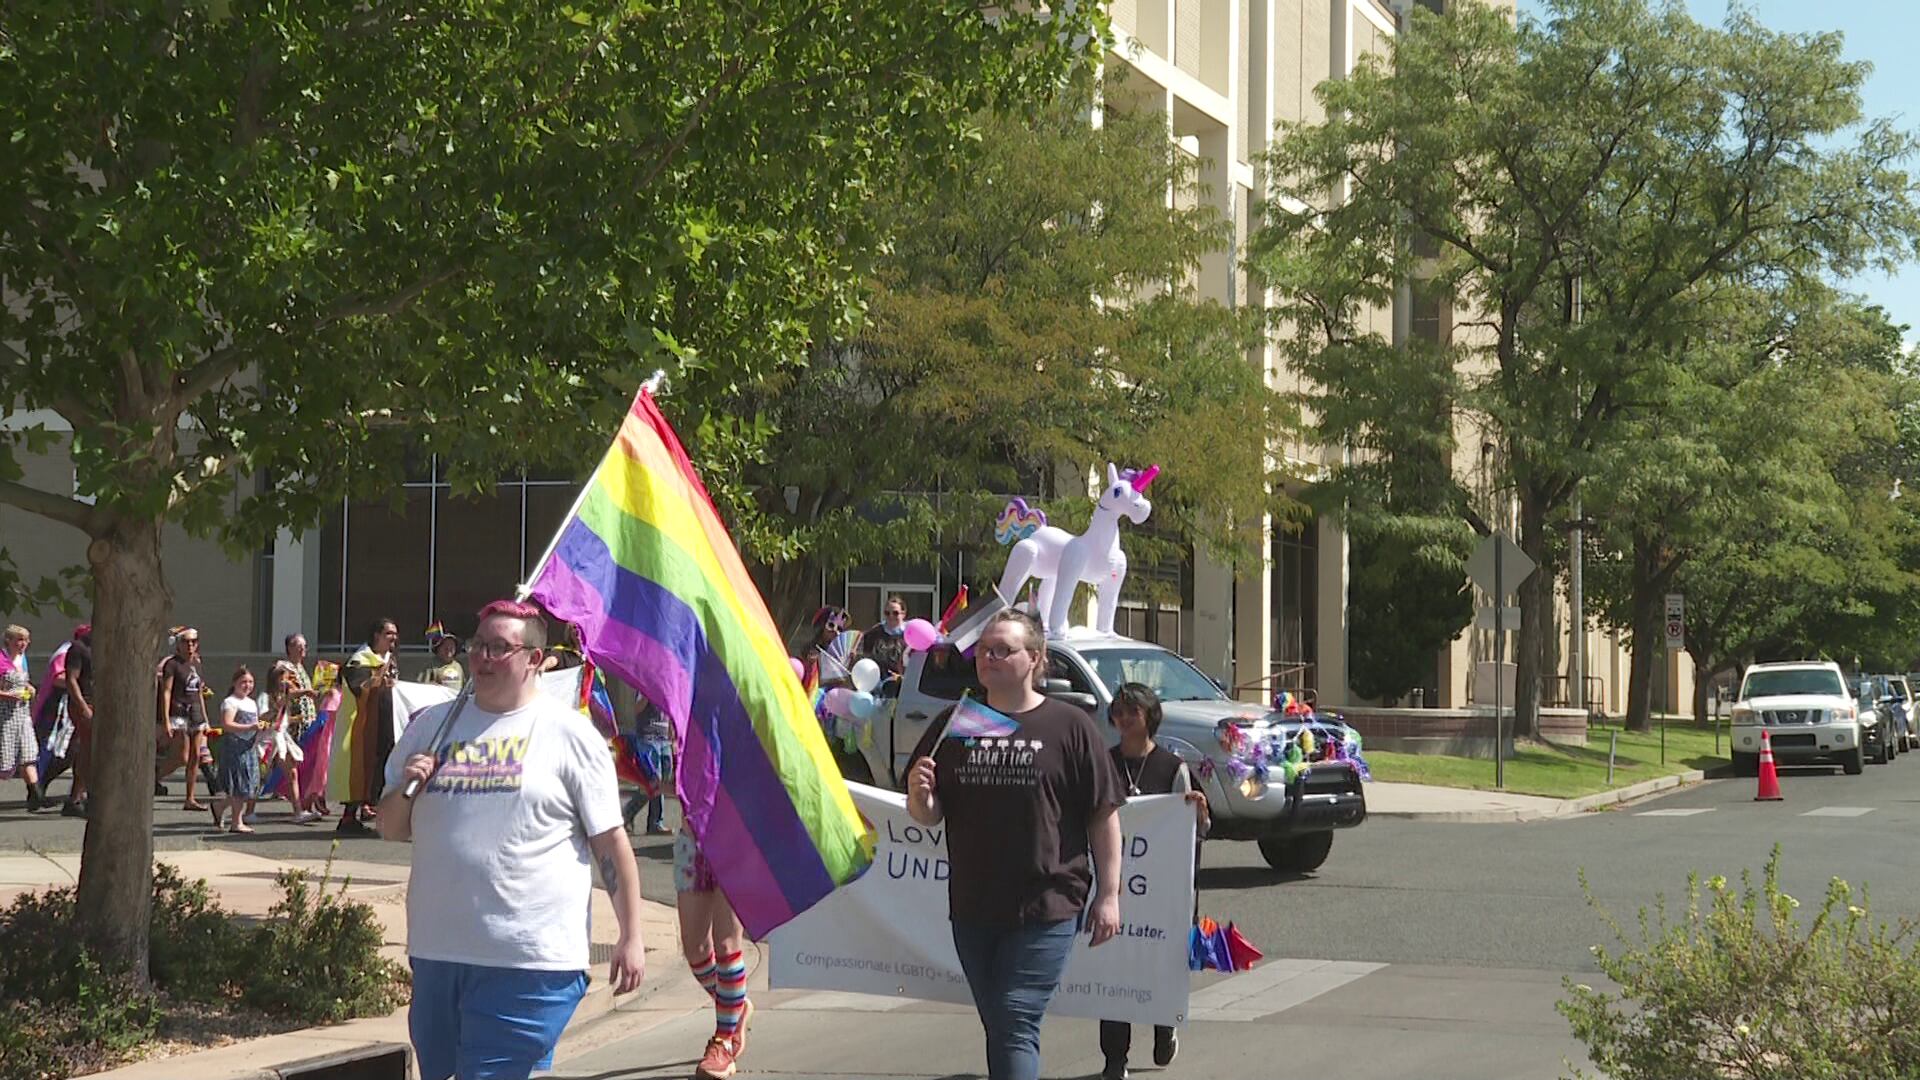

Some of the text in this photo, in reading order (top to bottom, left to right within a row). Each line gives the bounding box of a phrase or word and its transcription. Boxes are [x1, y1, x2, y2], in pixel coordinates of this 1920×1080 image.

[887, 819, 942, 847] LOV
[1127, 923, 1167, 940] Later.
[796, 952, 891, 974] Compassionate
[894, 962, 942, 981] LGBTQ+
[1066, 982, 1092, 995] and
[1095, 982, 1152, 1004] Trainings
